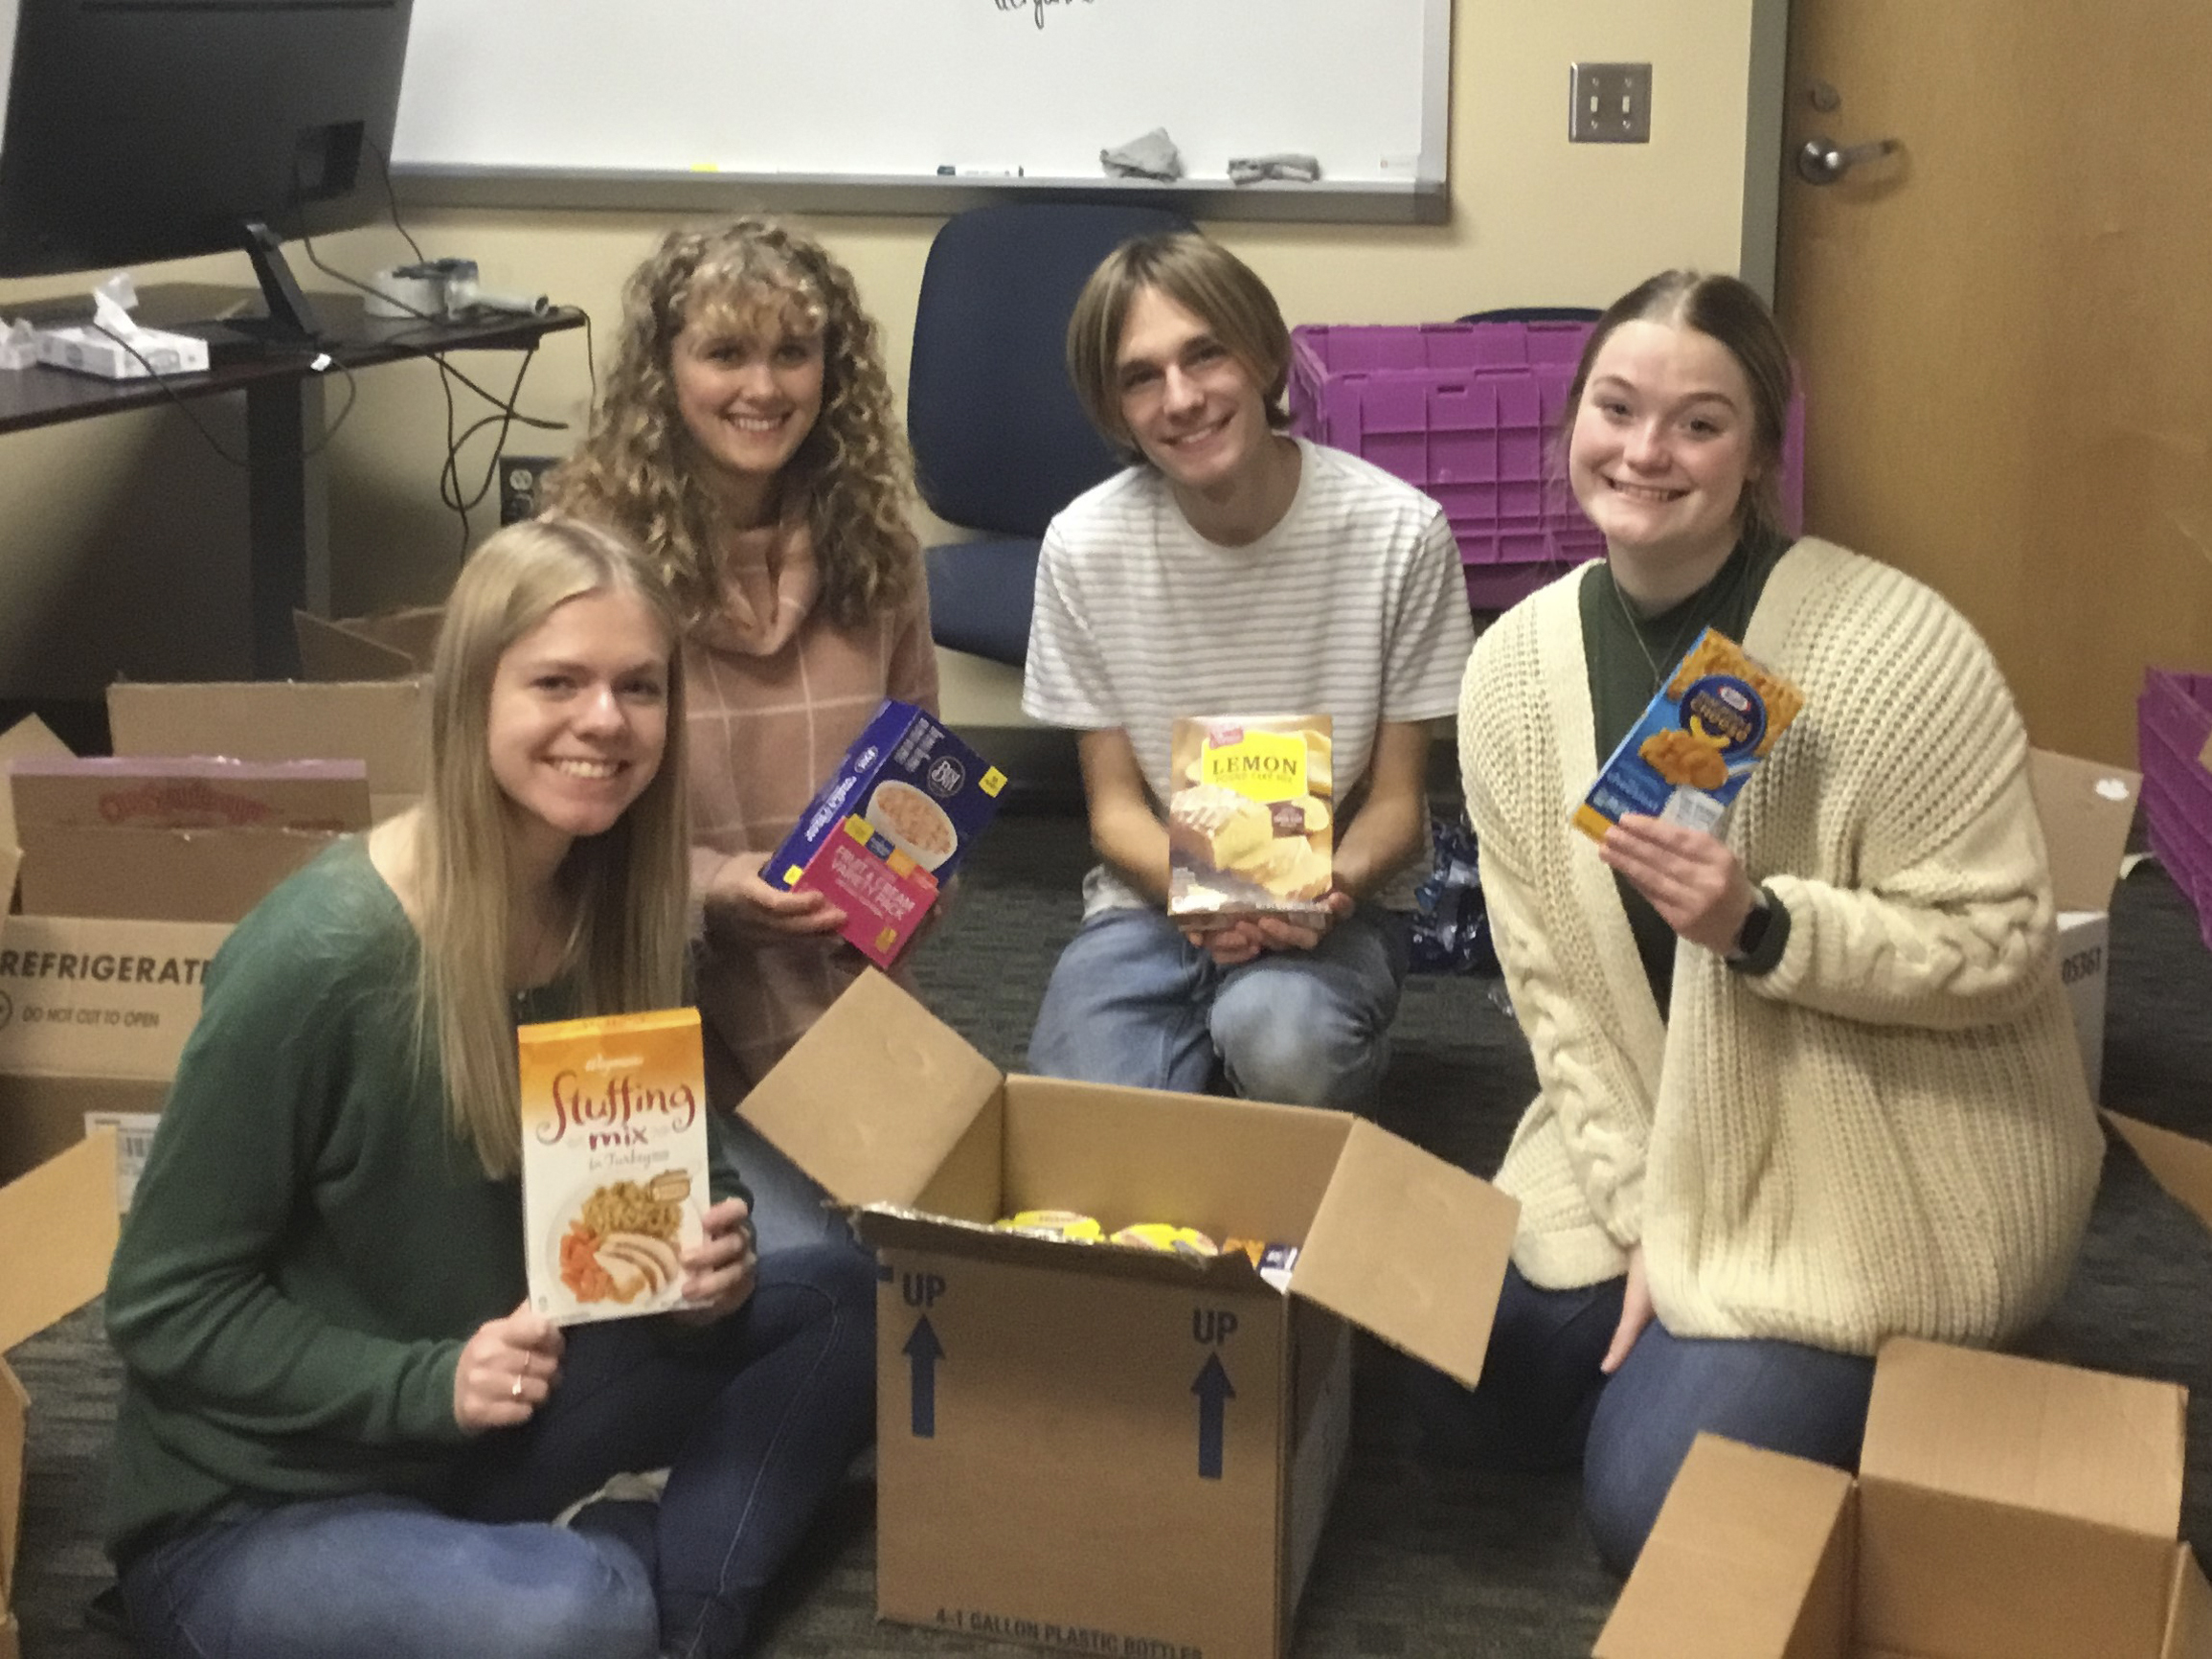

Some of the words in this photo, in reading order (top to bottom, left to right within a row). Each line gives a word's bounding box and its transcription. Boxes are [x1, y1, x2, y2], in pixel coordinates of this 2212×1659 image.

[1212, 756, 1298, 776] LEMON
[22, 1007, 44, 1022] DO
[48, 1008, 73, 1023] NOT
[103, 1010, 121, 1026] TO
[124, 1011, 160, 1028] OPEN
[536, 1070, 695, 1146] Stuffing
[589, 1125, 648, 1151] mix
[902, 1272, 947, 1307] UP
[1192, 1307, 1239, 1346] UP
